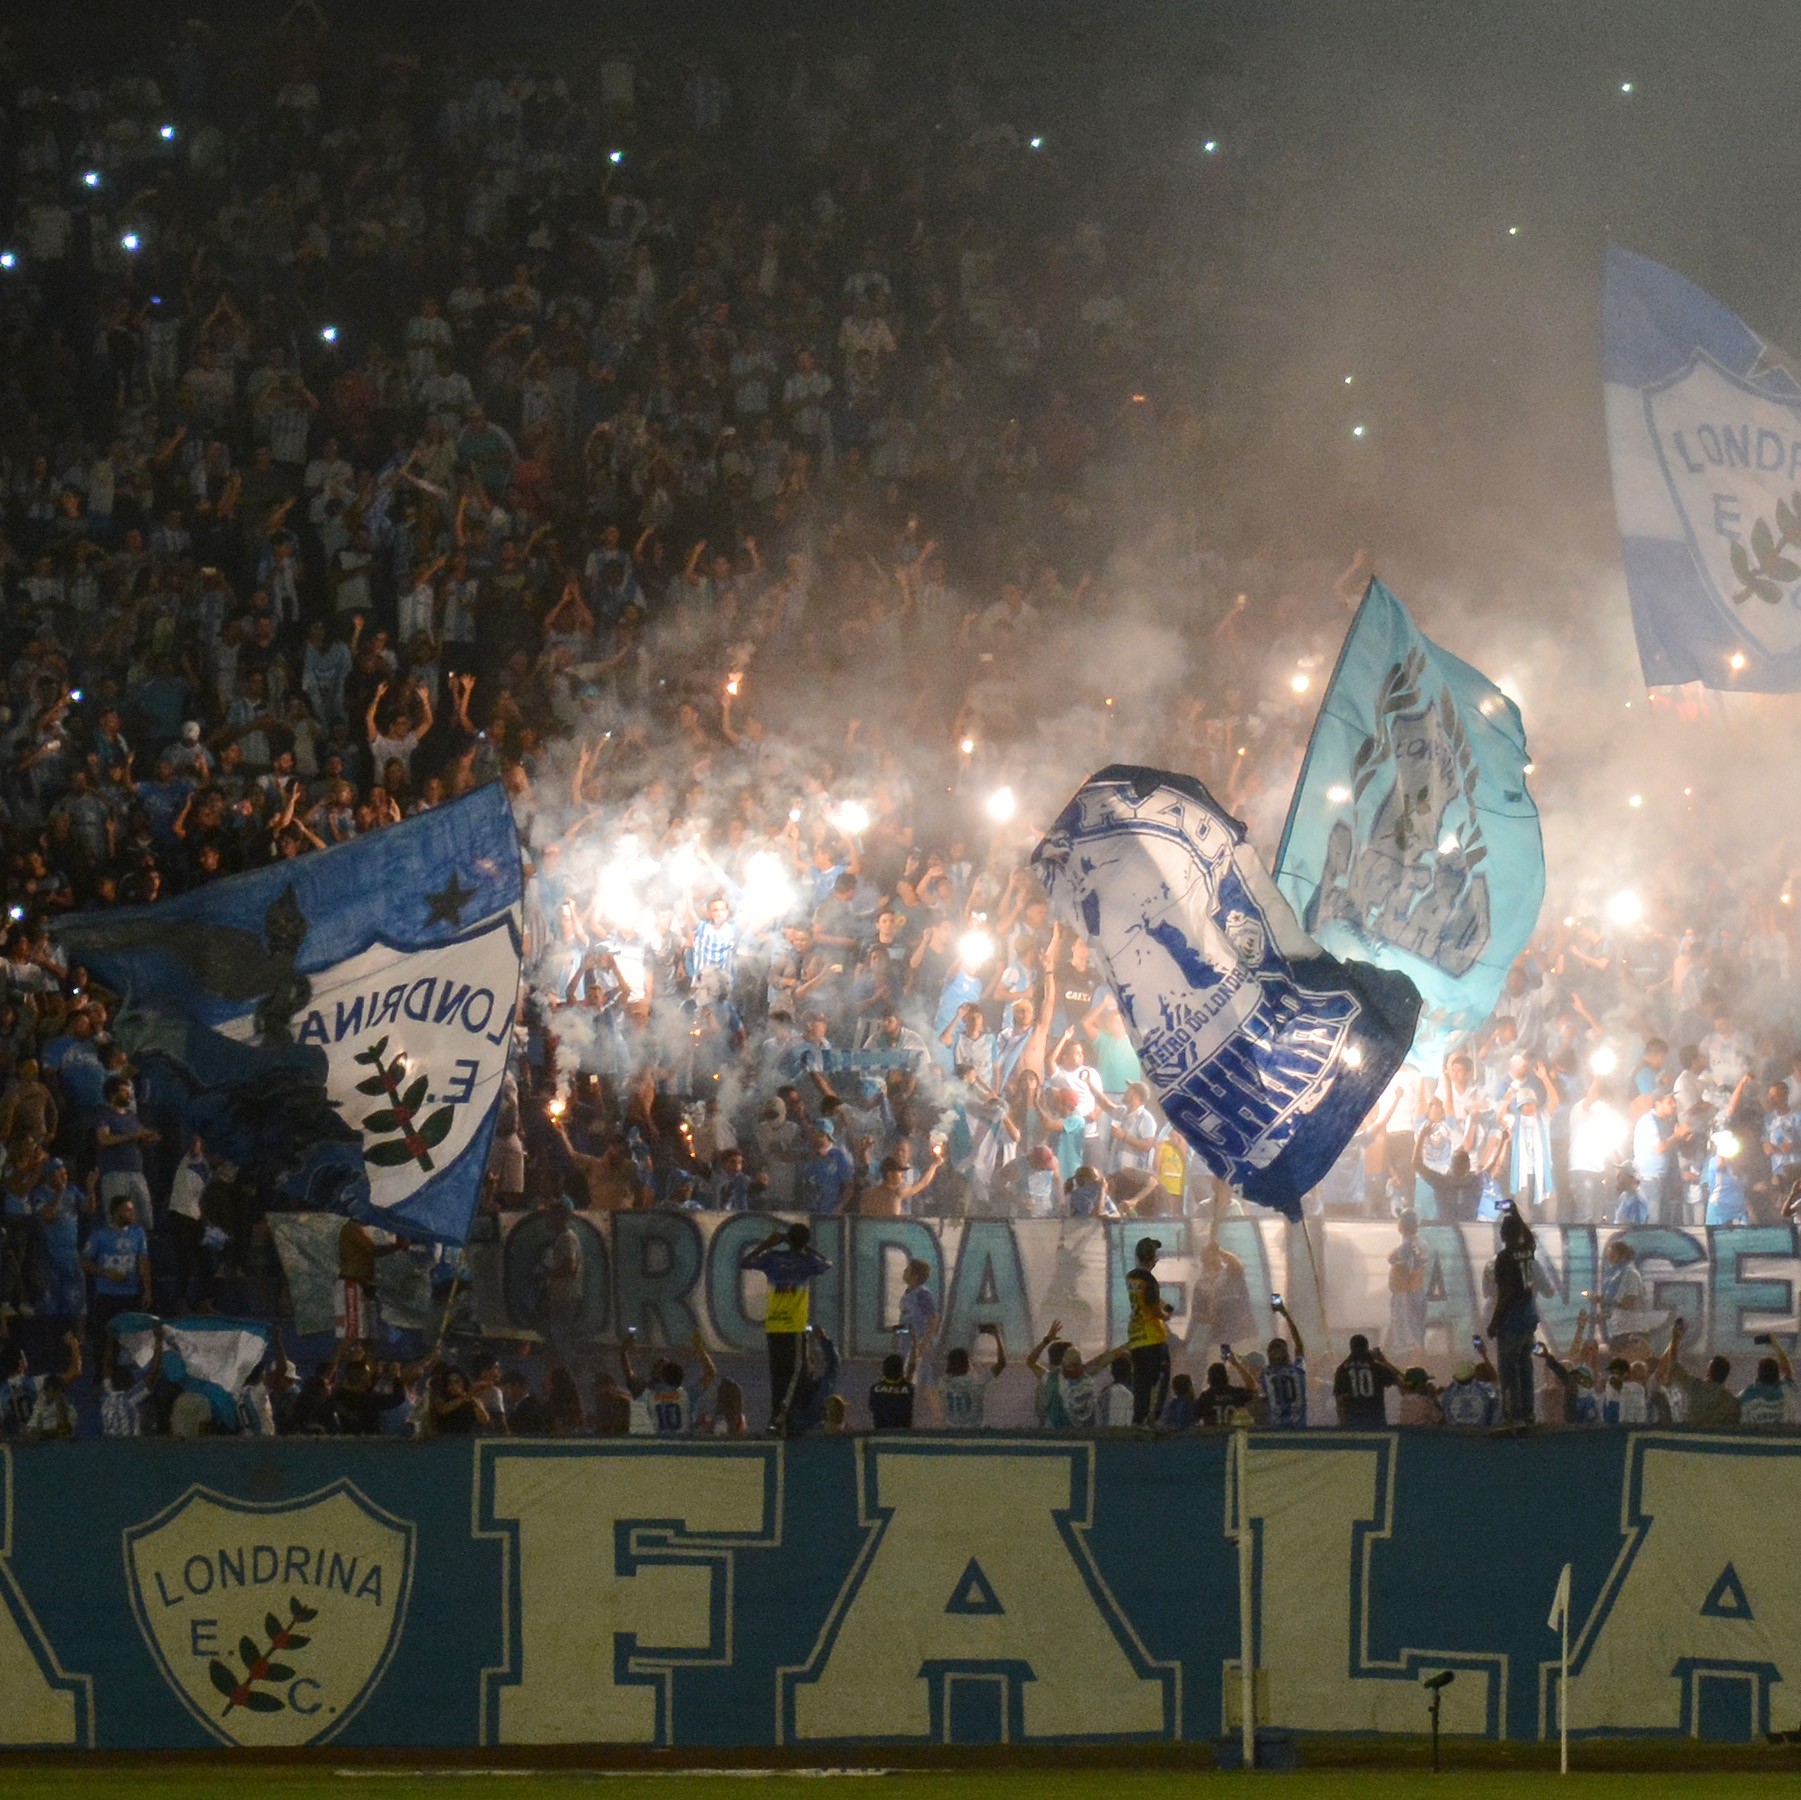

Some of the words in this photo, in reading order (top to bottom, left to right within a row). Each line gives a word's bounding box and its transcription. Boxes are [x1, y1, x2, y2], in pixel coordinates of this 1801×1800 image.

[1713, 492, 1743, 540] E
[1184, 1006, 1211, 1034] DO
[468, 1208, 1037, 1368] ORCIDA
[1348, 1368, 1374, 1398] 10
[655, 1403, 682, 1430] 10
[154, 1545, 384, 1609] LONDRINA
